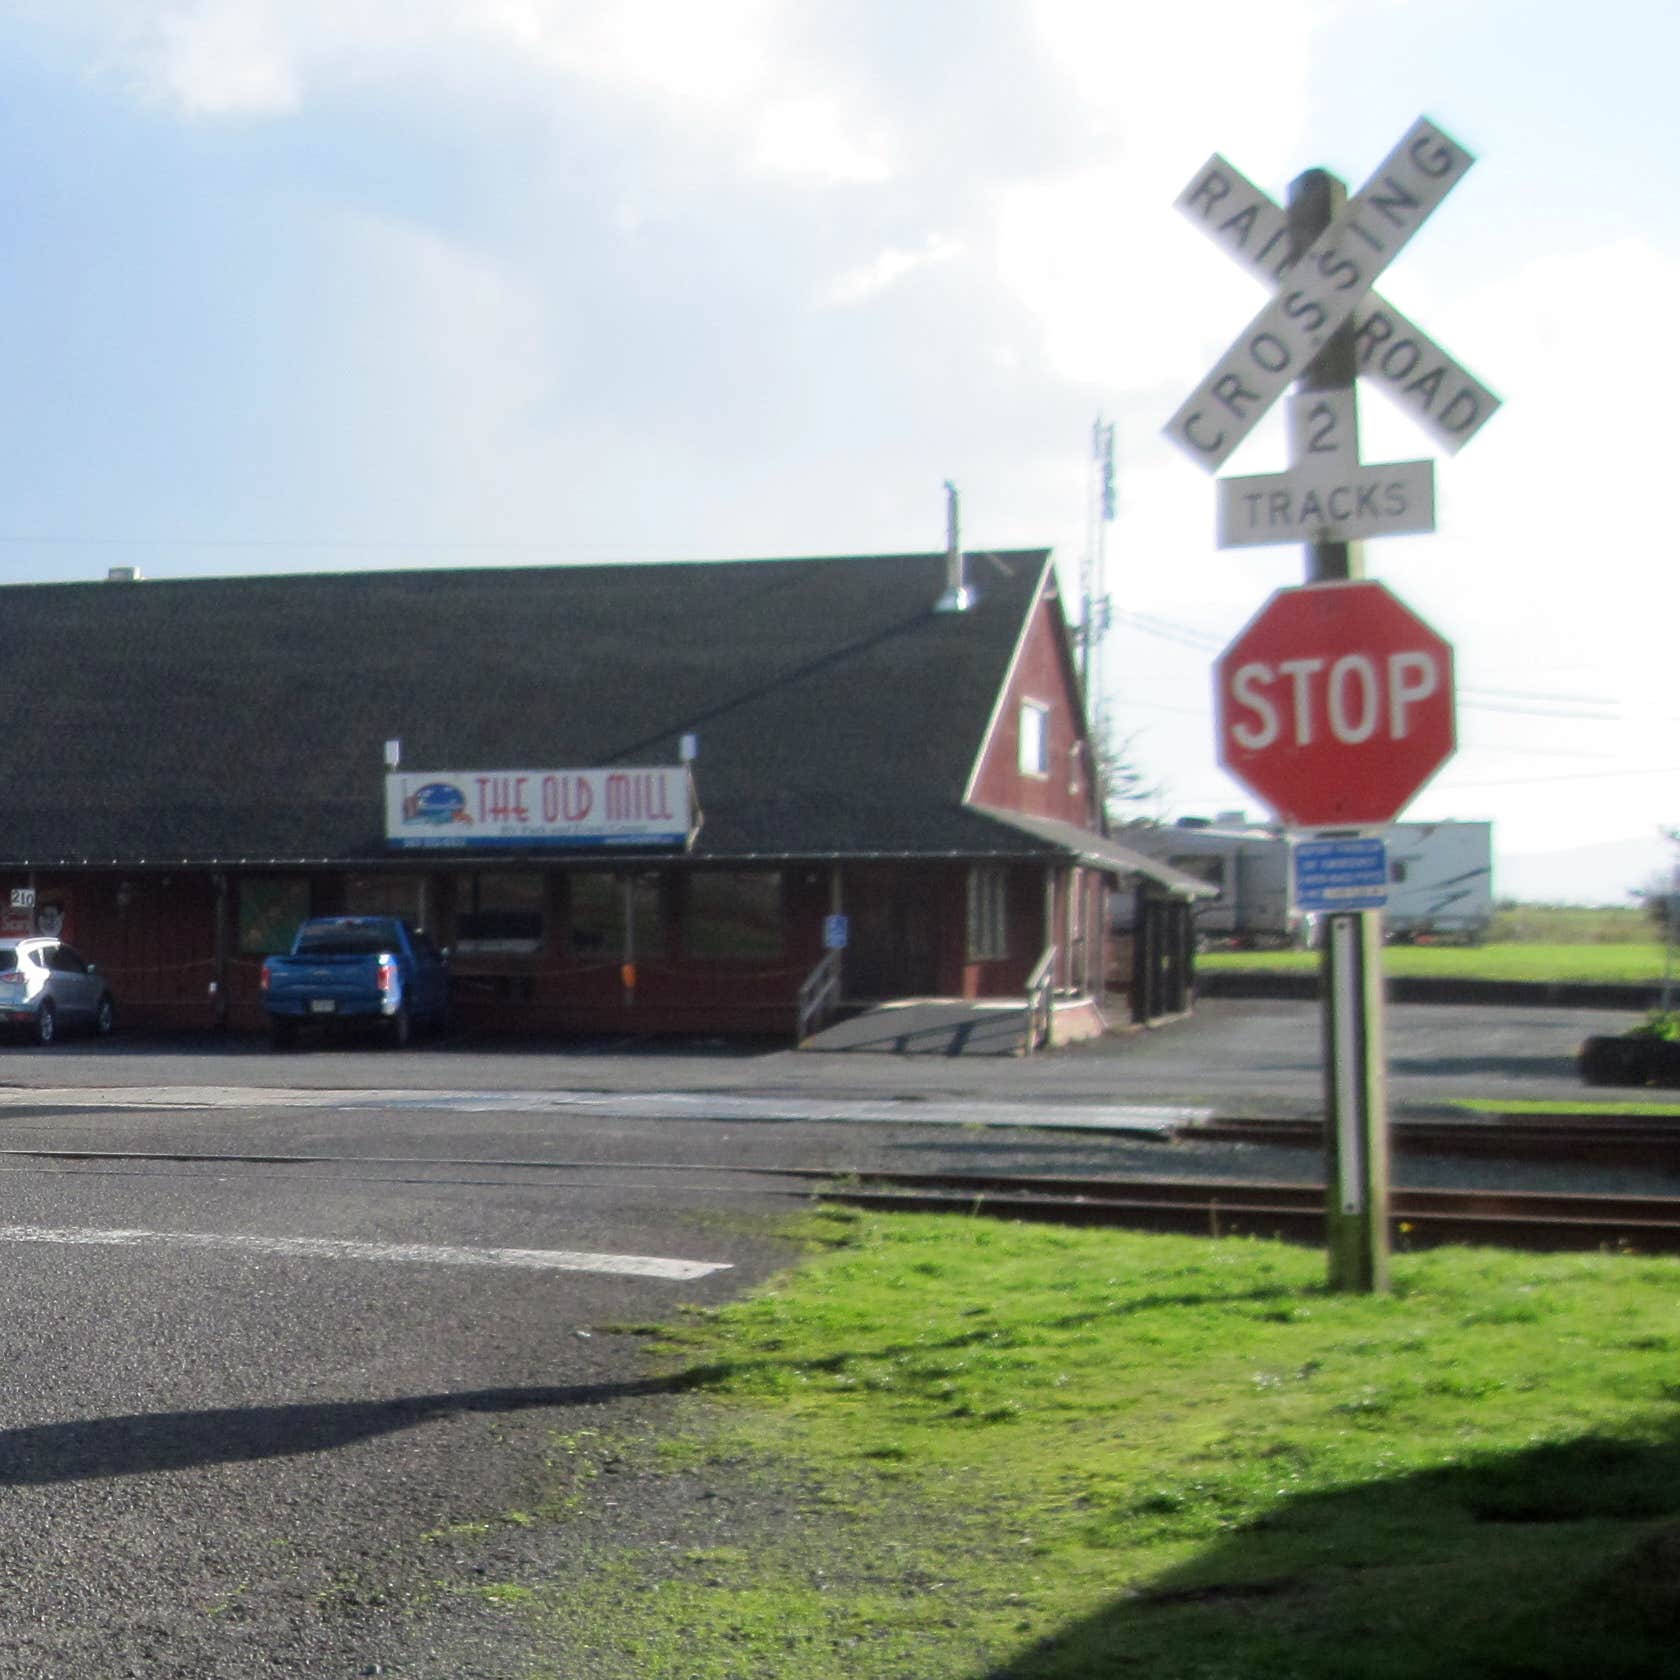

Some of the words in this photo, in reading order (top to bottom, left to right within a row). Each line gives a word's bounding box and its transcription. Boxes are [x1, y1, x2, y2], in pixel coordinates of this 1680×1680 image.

[1181, 135, 1455, 455] CROSSING
[1354, 311, 1480, 433] ROAD
[1308, 405, 1340, 453] 2
[1242, 482, 1408, 529] TRACKS
[1231, 652, 1438, 750] STOP
[476, 777, 529, 822] THE
[542, 775, 593, 821] OLD
[606, 774, 673, 820] MILL
[11, 890, 34, 905] 210
